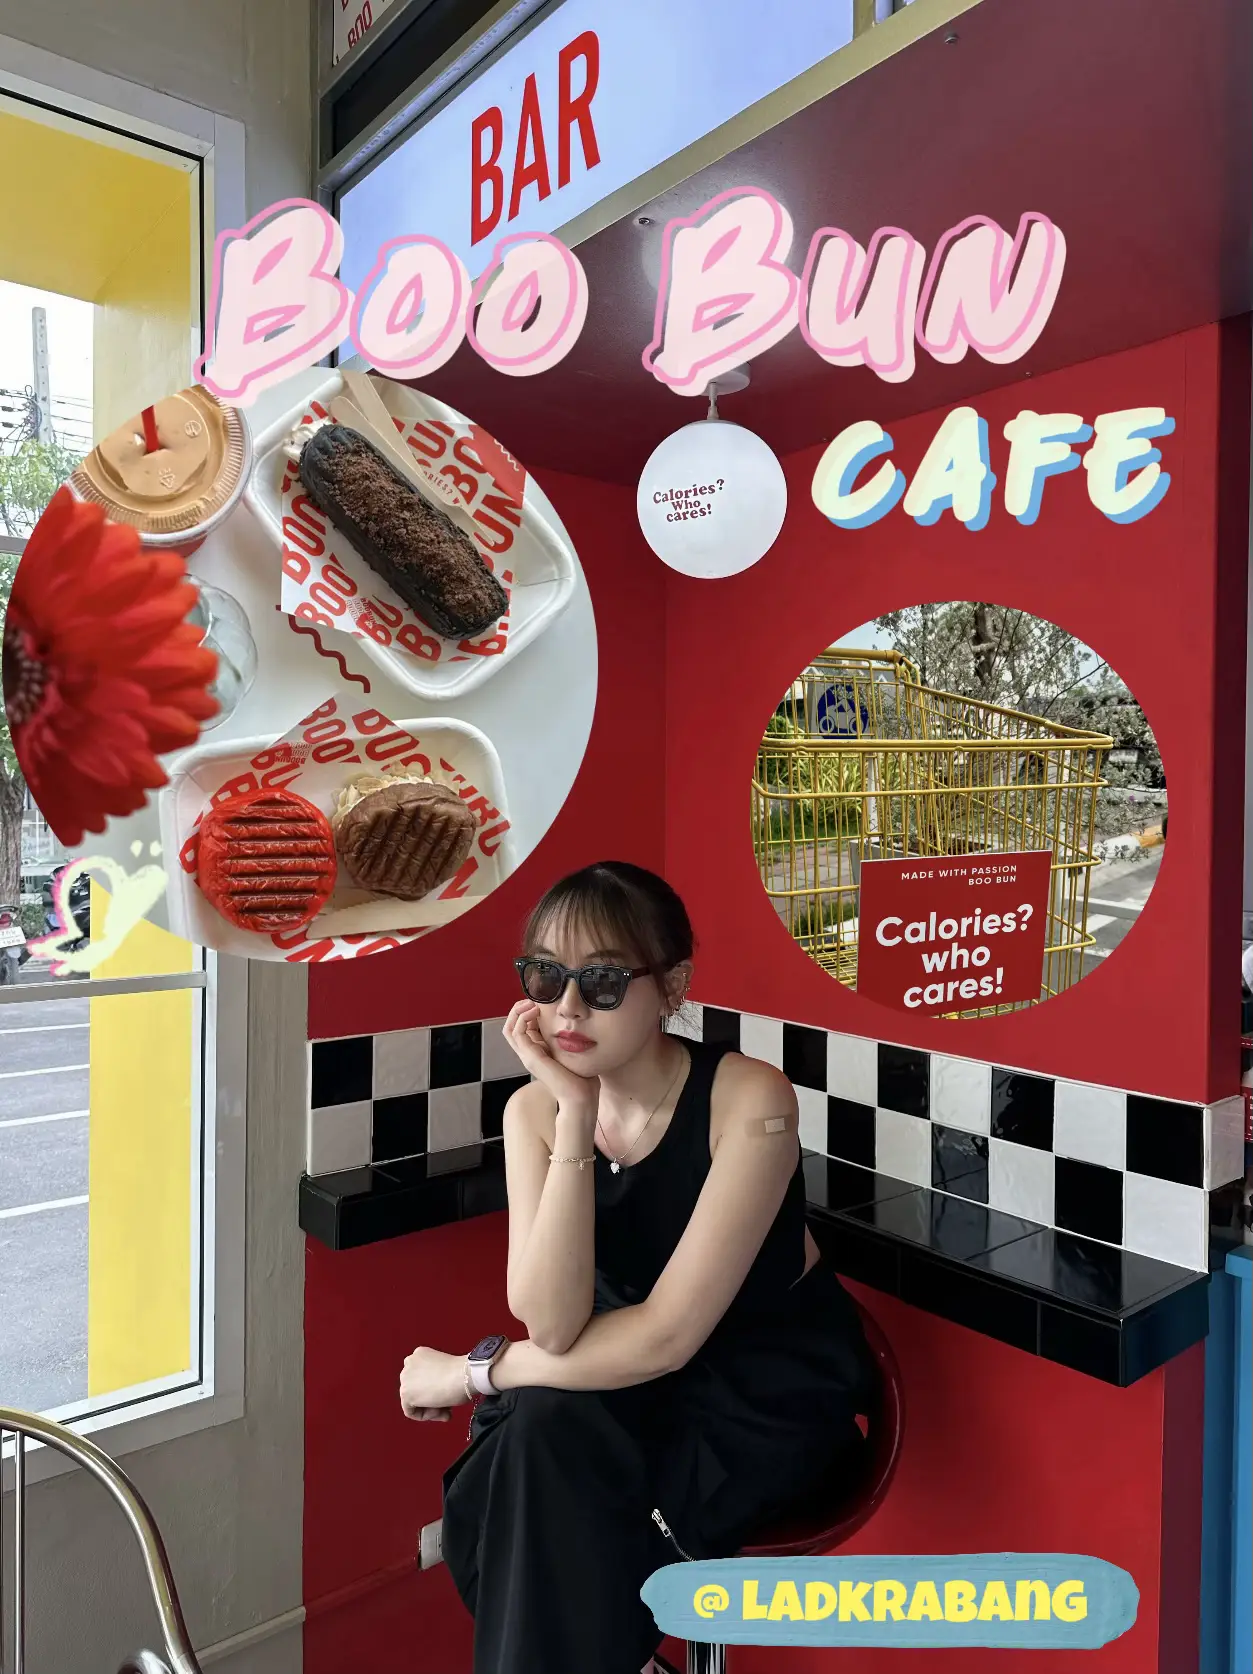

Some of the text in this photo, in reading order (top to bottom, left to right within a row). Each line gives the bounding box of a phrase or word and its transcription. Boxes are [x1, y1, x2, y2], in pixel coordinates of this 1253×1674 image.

[470, 30, 601, 247] BAR
[653, 478, 725, 504] Calories?
[666, 503, 712, 523] cares!
[671, 499, 701, 512] Who
[901, 865, 1017, 880] MADE WITH PASSION
[968, 875, 1017, 886] BOO BUN
[875, 903, 1034, 947] Calories?
[921, 942, 991, 974] who
[903, 966, 1004, 1008] cares!
